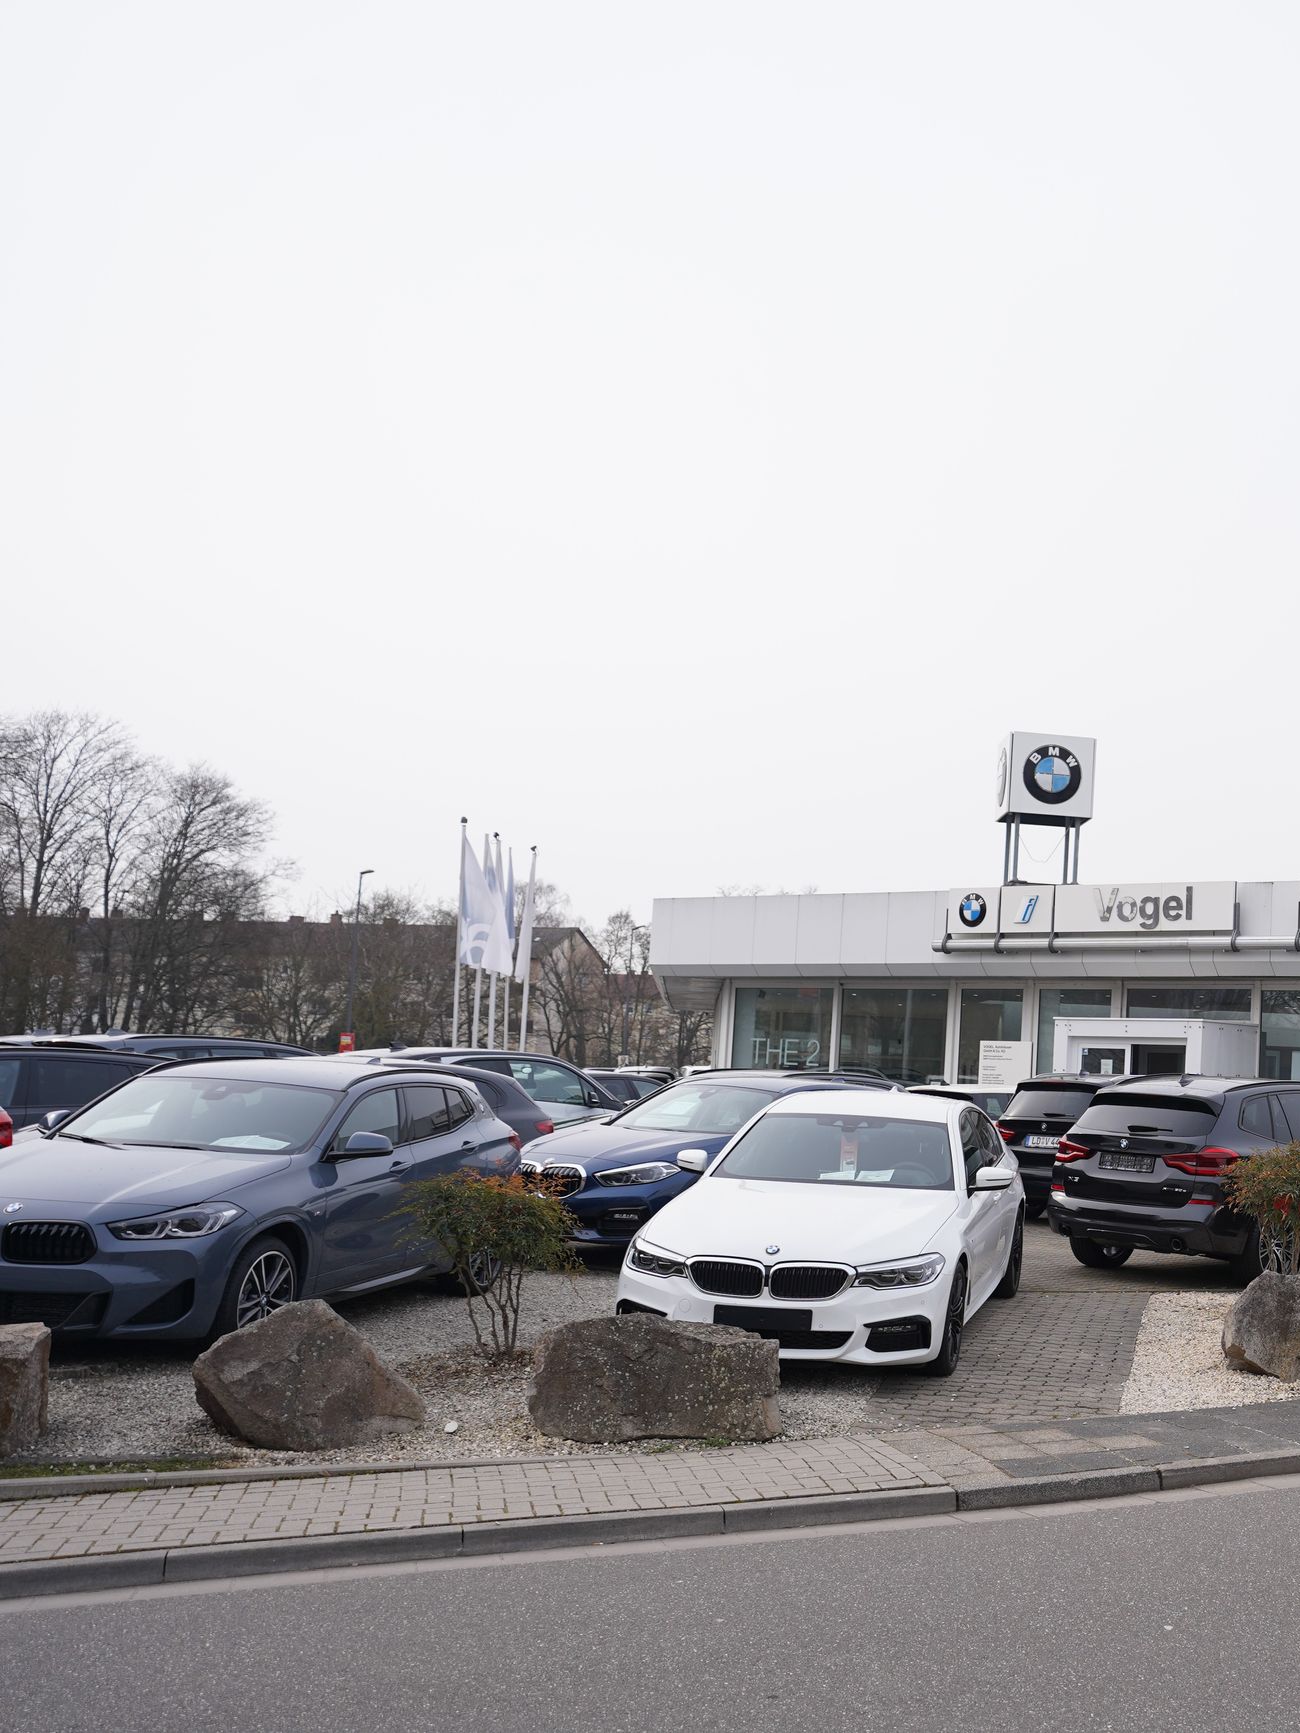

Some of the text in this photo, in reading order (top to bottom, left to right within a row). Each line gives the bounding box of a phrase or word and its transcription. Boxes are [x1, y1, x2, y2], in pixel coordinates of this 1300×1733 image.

[1029, 746, 1078, 768] BMW
[1092, 886, 1193, 930] Vogel
[751, 1038, 820, 1067] THE 2
